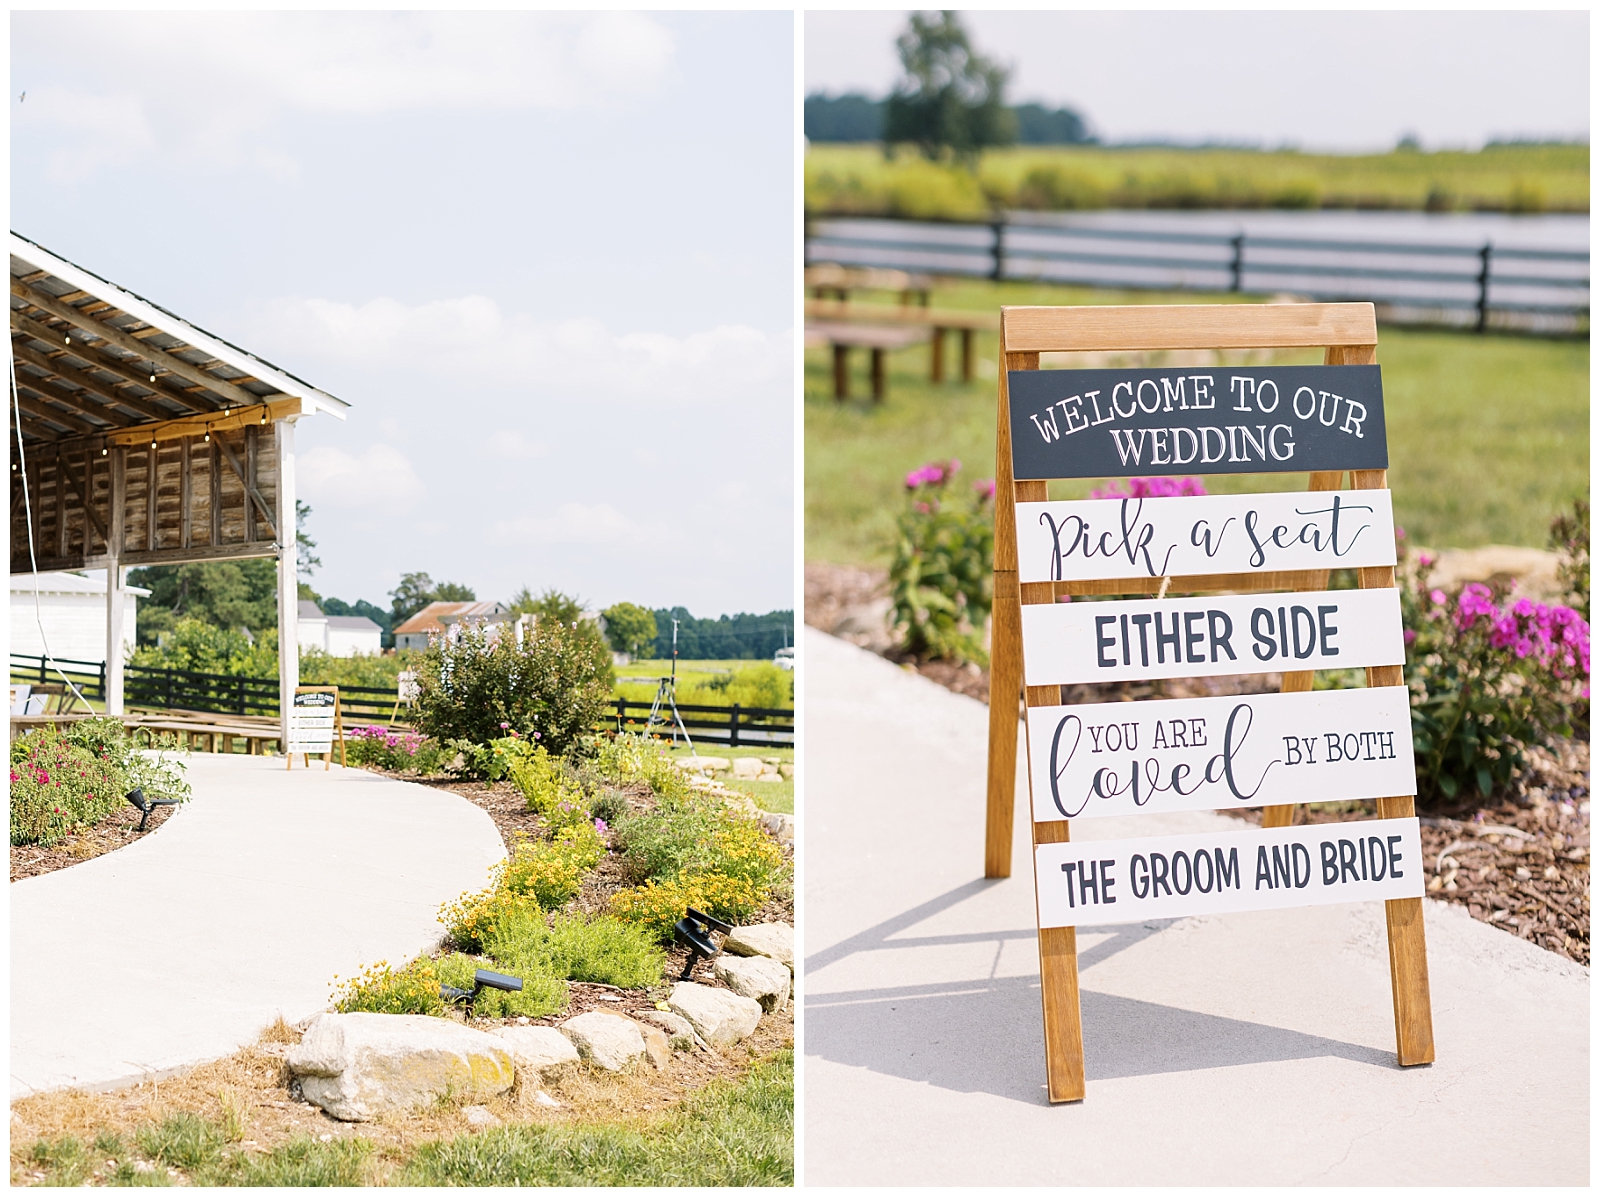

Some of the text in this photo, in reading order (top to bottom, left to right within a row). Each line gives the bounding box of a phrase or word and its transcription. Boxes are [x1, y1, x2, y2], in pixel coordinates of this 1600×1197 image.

[1030, 375, 1368, 444] WELCOME TO OUR
[1109, 424, 1296, 467] WEDDING
[1190, 517, 1236, 557] a
[1095, 605, 1340, 667] EITHER SIDE
[1049, 703, 1397, 818] loved BY BOTH
[1087, 718, 1208, 754] YOU ARE
[1061, 835, 1404, 908] THE GROOM AND BRIDE
